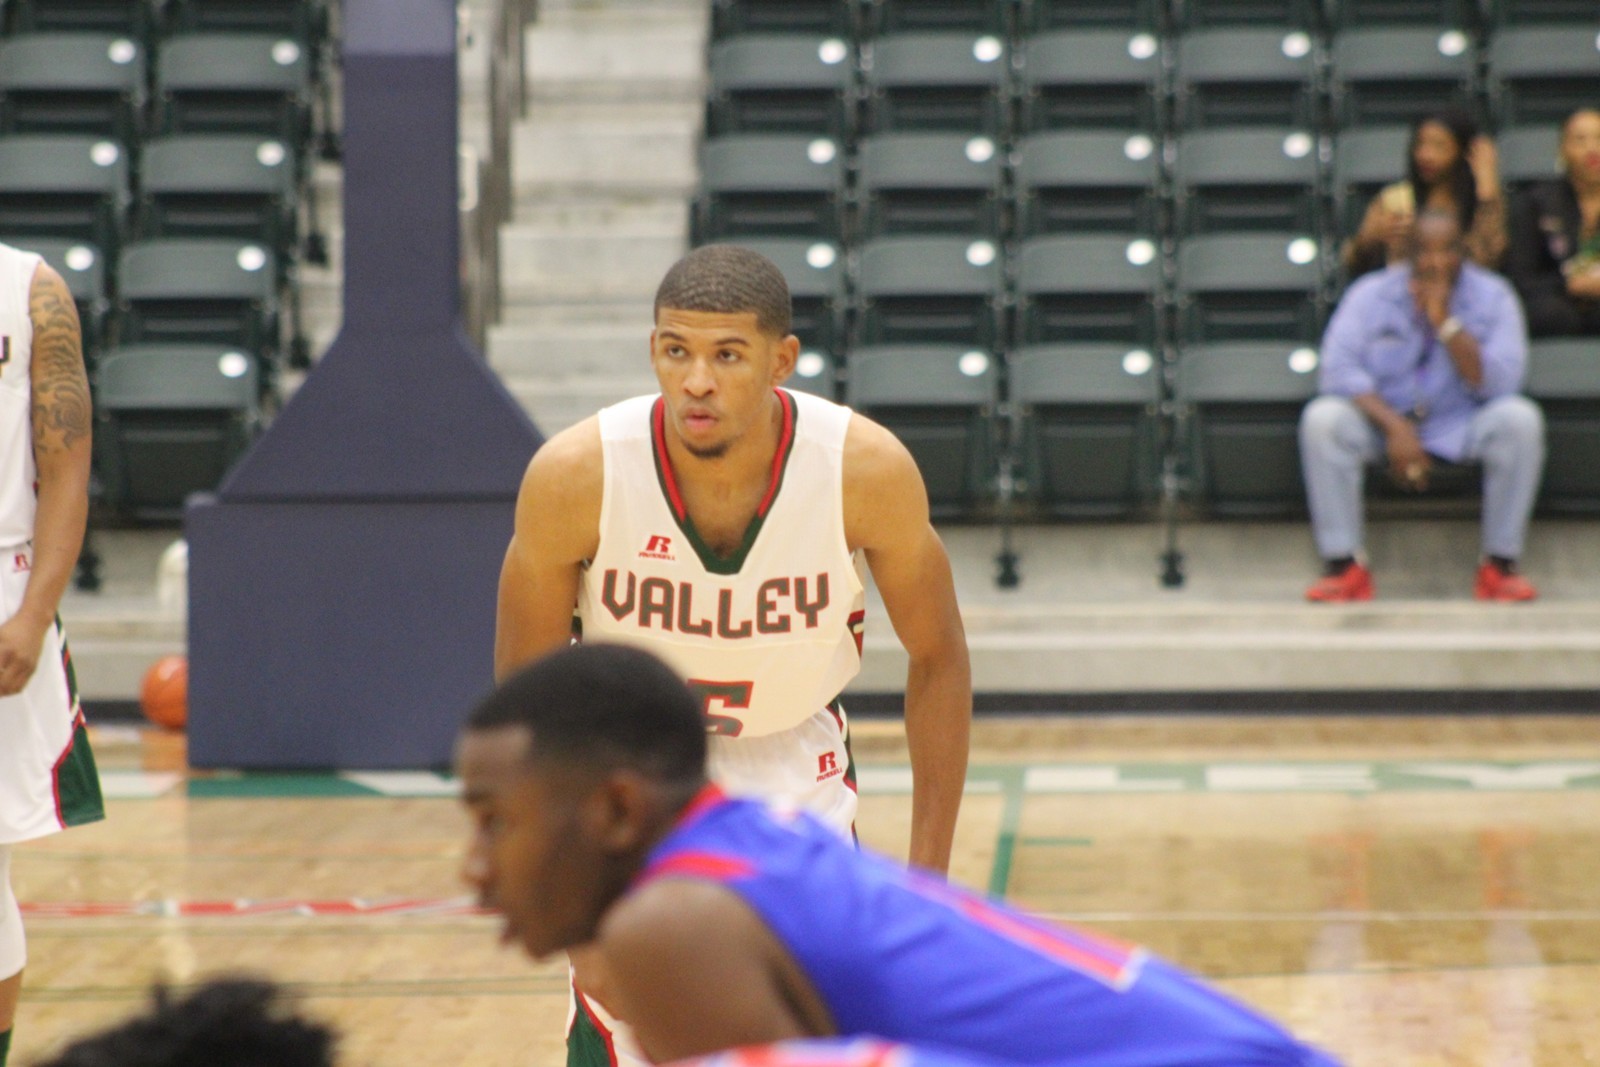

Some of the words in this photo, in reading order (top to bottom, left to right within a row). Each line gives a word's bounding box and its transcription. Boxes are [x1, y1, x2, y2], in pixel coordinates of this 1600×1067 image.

[646, 534, 671, 553] R
[601, 568, 830, 639] VALLEY
[818, 751, 836, 774] R
